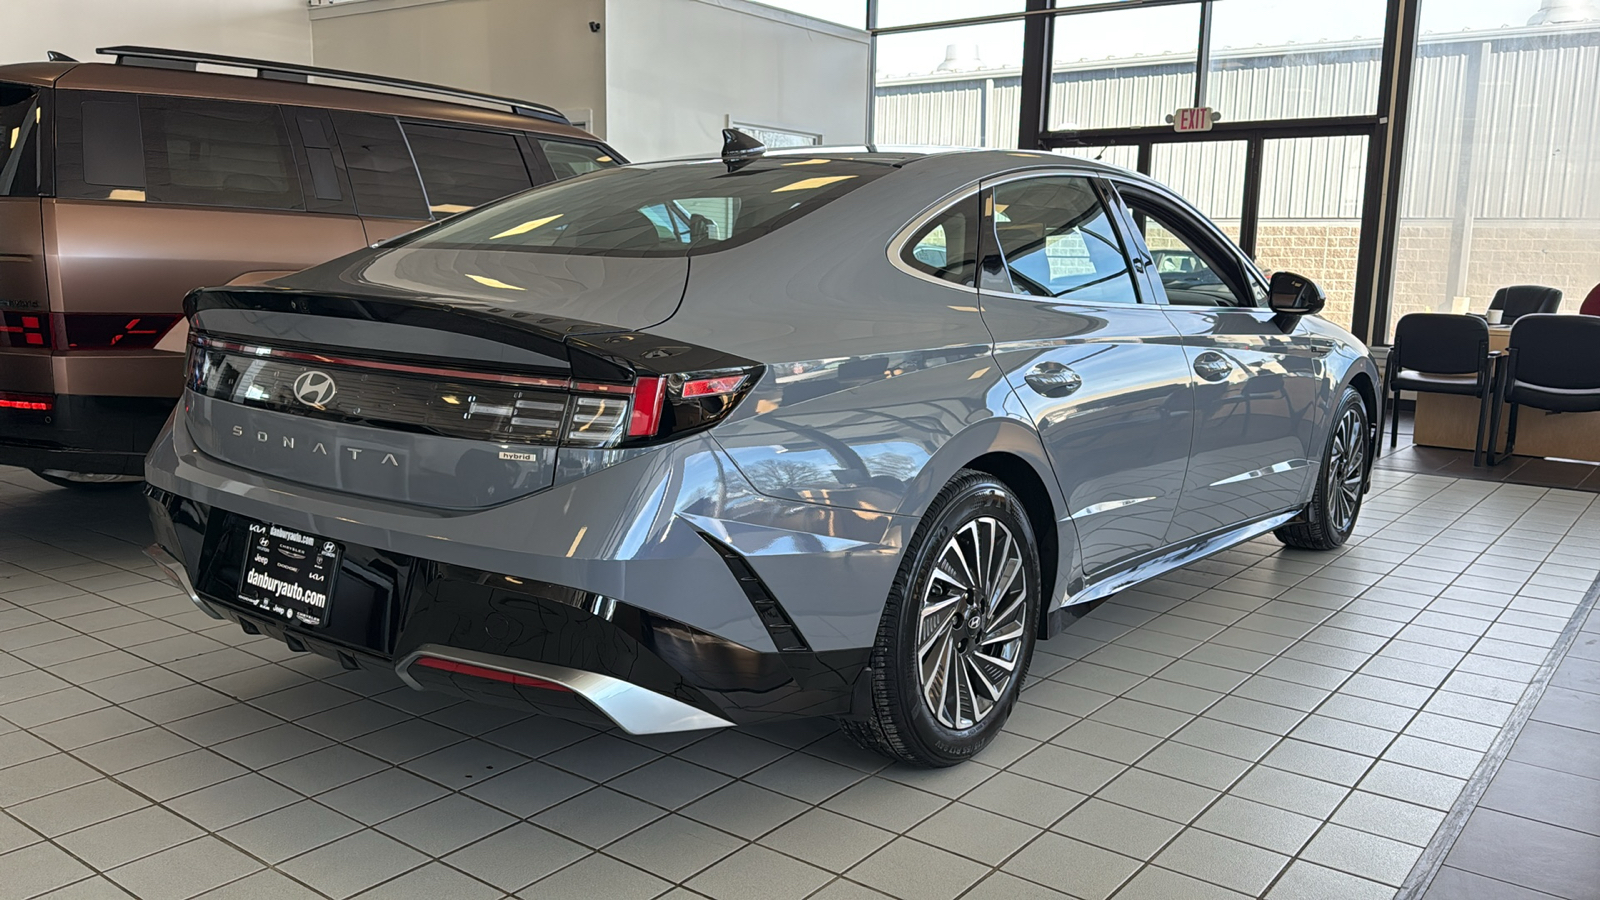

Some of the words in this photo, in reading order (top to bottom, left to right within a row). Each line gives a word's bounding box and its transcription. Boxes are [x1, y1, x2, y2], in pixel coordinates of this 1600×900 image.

[1180, 108, 1207, 129] EXIT
[232, 425, 399, 467] SONATA
[503, 452, 531, 460] hybrid
[270, 526, 314, 546] danburyauto.com
[279, 543, 305, 554] CHRYSLER
[254, 553, 268, 565] Jeep
[247, 567, 326, 608] danburyauto.com
[272, 604, 285, 615] Jeep
